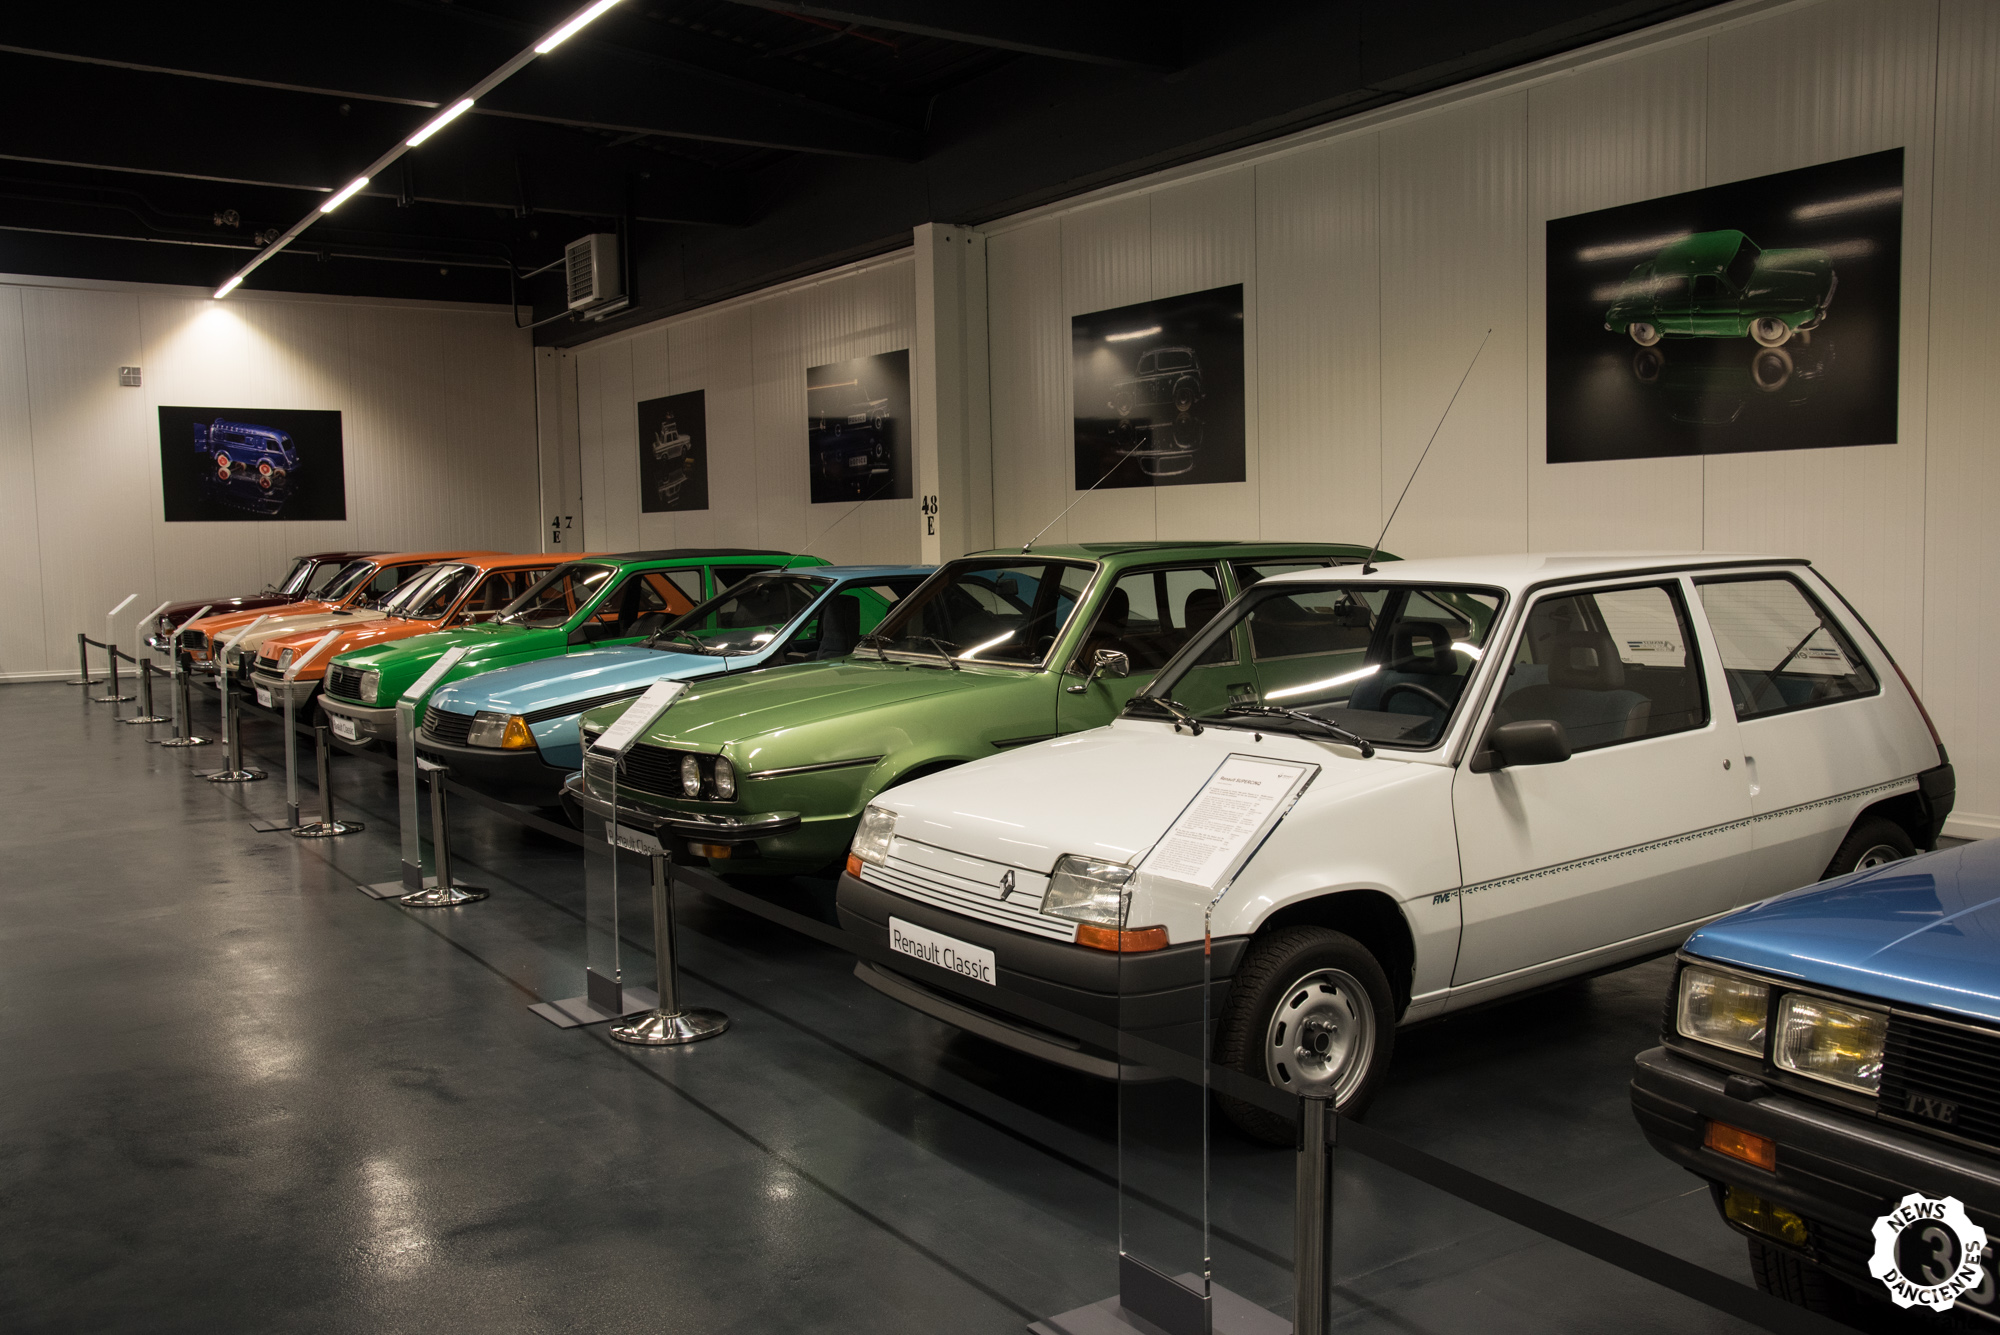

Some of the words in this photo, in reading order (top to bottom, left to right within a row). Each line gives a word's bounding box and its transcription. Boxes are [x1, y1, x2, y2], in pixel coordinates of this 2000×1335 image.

[922, 495, 938, 515] 48
[927, 516, 935, 535] E
[553, 531, 561, 543] E
[1432, 893, 1450, 905] FIVE
[893, 929, 939, 965] Renault
[943, 948, 990, 982] Classic
[1905, 1095, 1955, 1124] TXE
